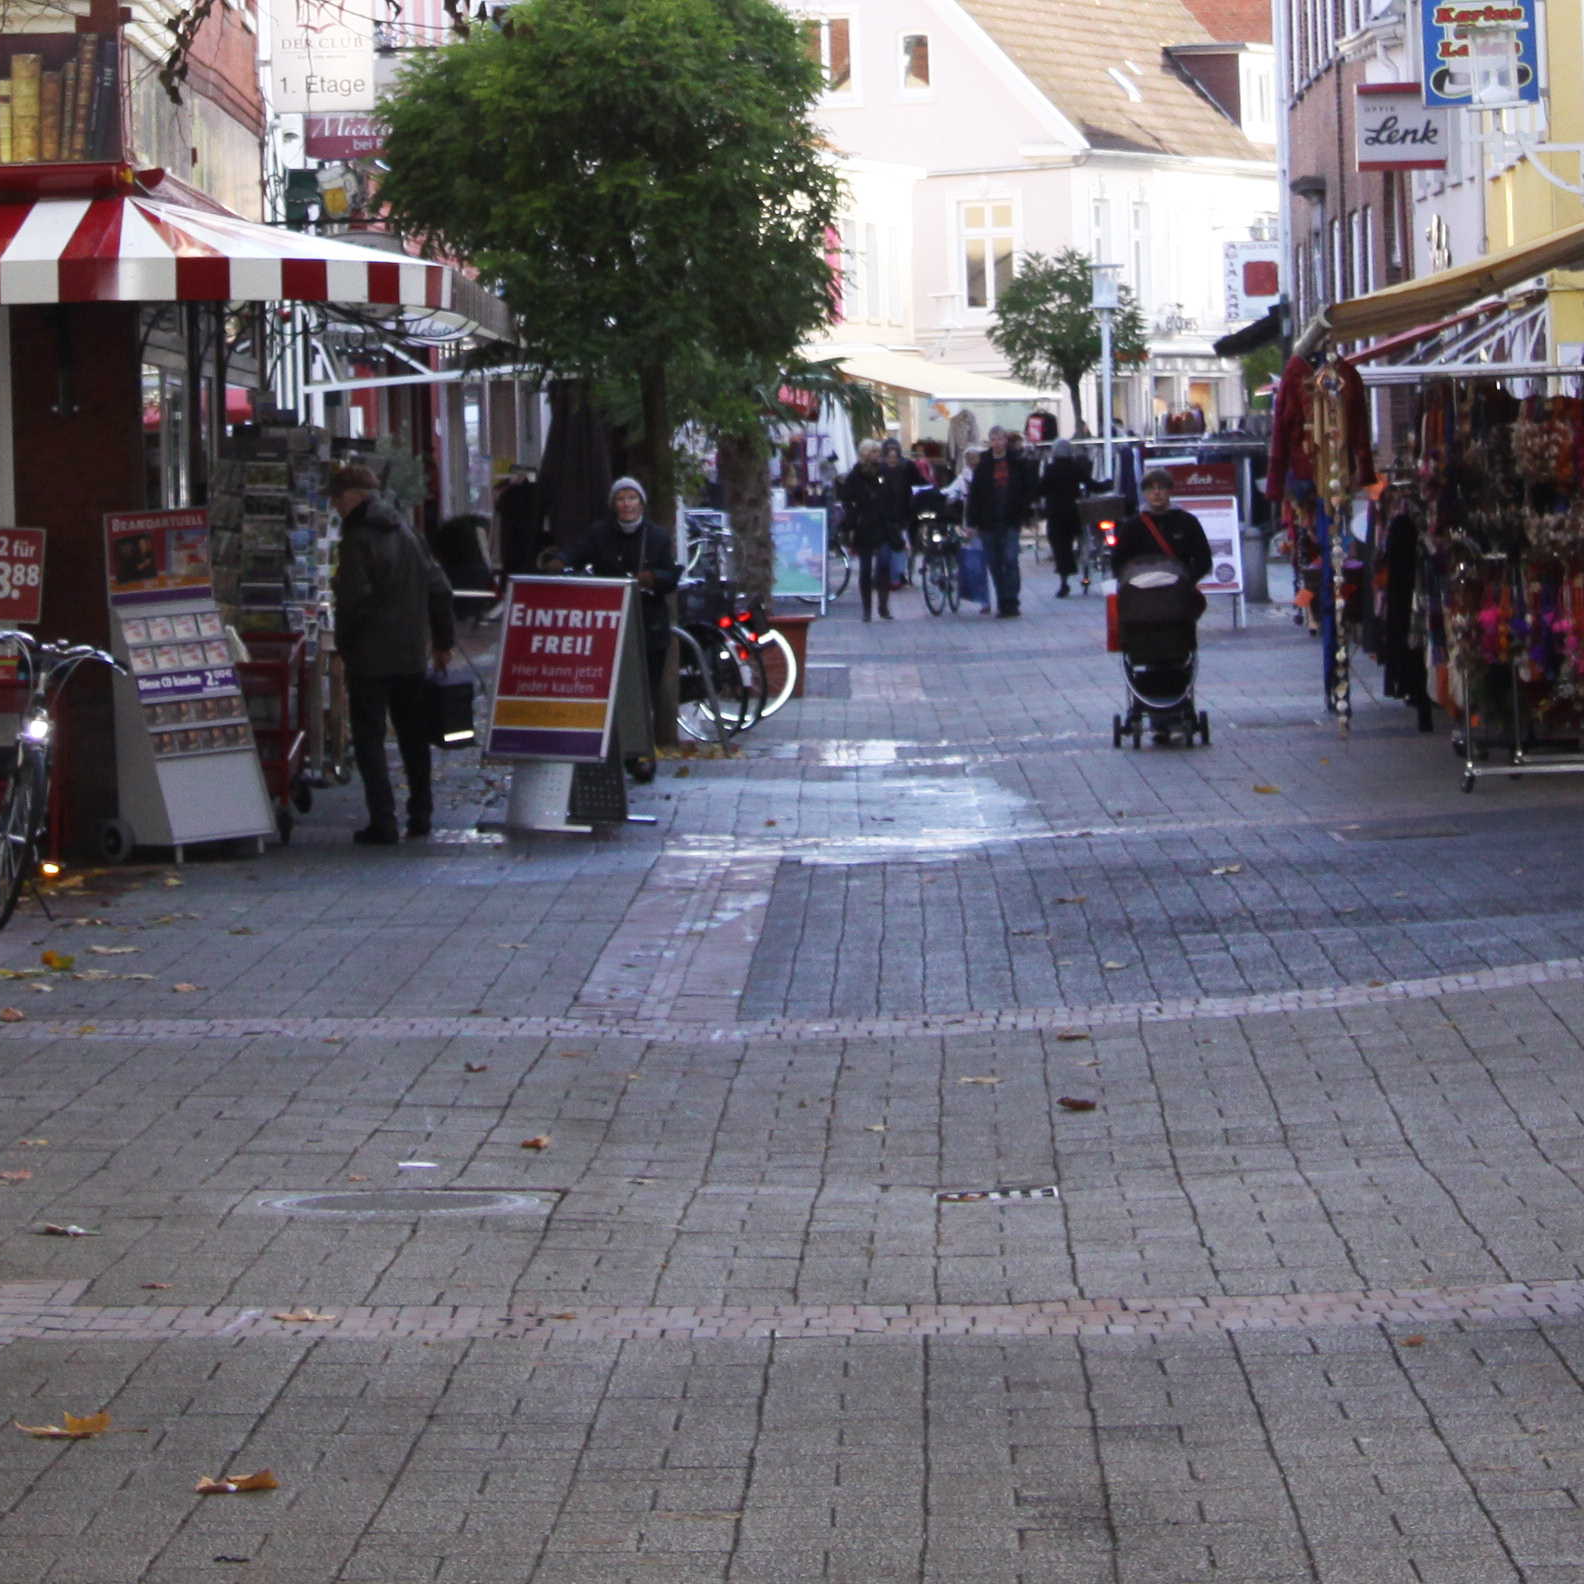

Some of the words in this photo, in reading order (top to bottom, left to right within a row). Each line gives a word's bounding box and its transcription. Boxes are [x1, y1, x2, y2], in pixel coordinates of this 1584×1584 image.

[280, 38, 315, 50] DER
[318, 36, 363, 49] CLUB
[280, 77, 297, 95] 1.
[305, 73, 366, 98] Etage
[1364, 115, 1439, 147] Lenk
[12, 539, 36, 558] für
[509, 602, 622, 630] EINTRITT
[530, 634, 594, 657] FREI!
[511, 665, 537, 677] Hier
[541, 665, 572, 677] kann
[574, 665, 604, 680] jetzt
[516, 680, 549, 695] jeder
[551, 680, 594, 694] kaufen
